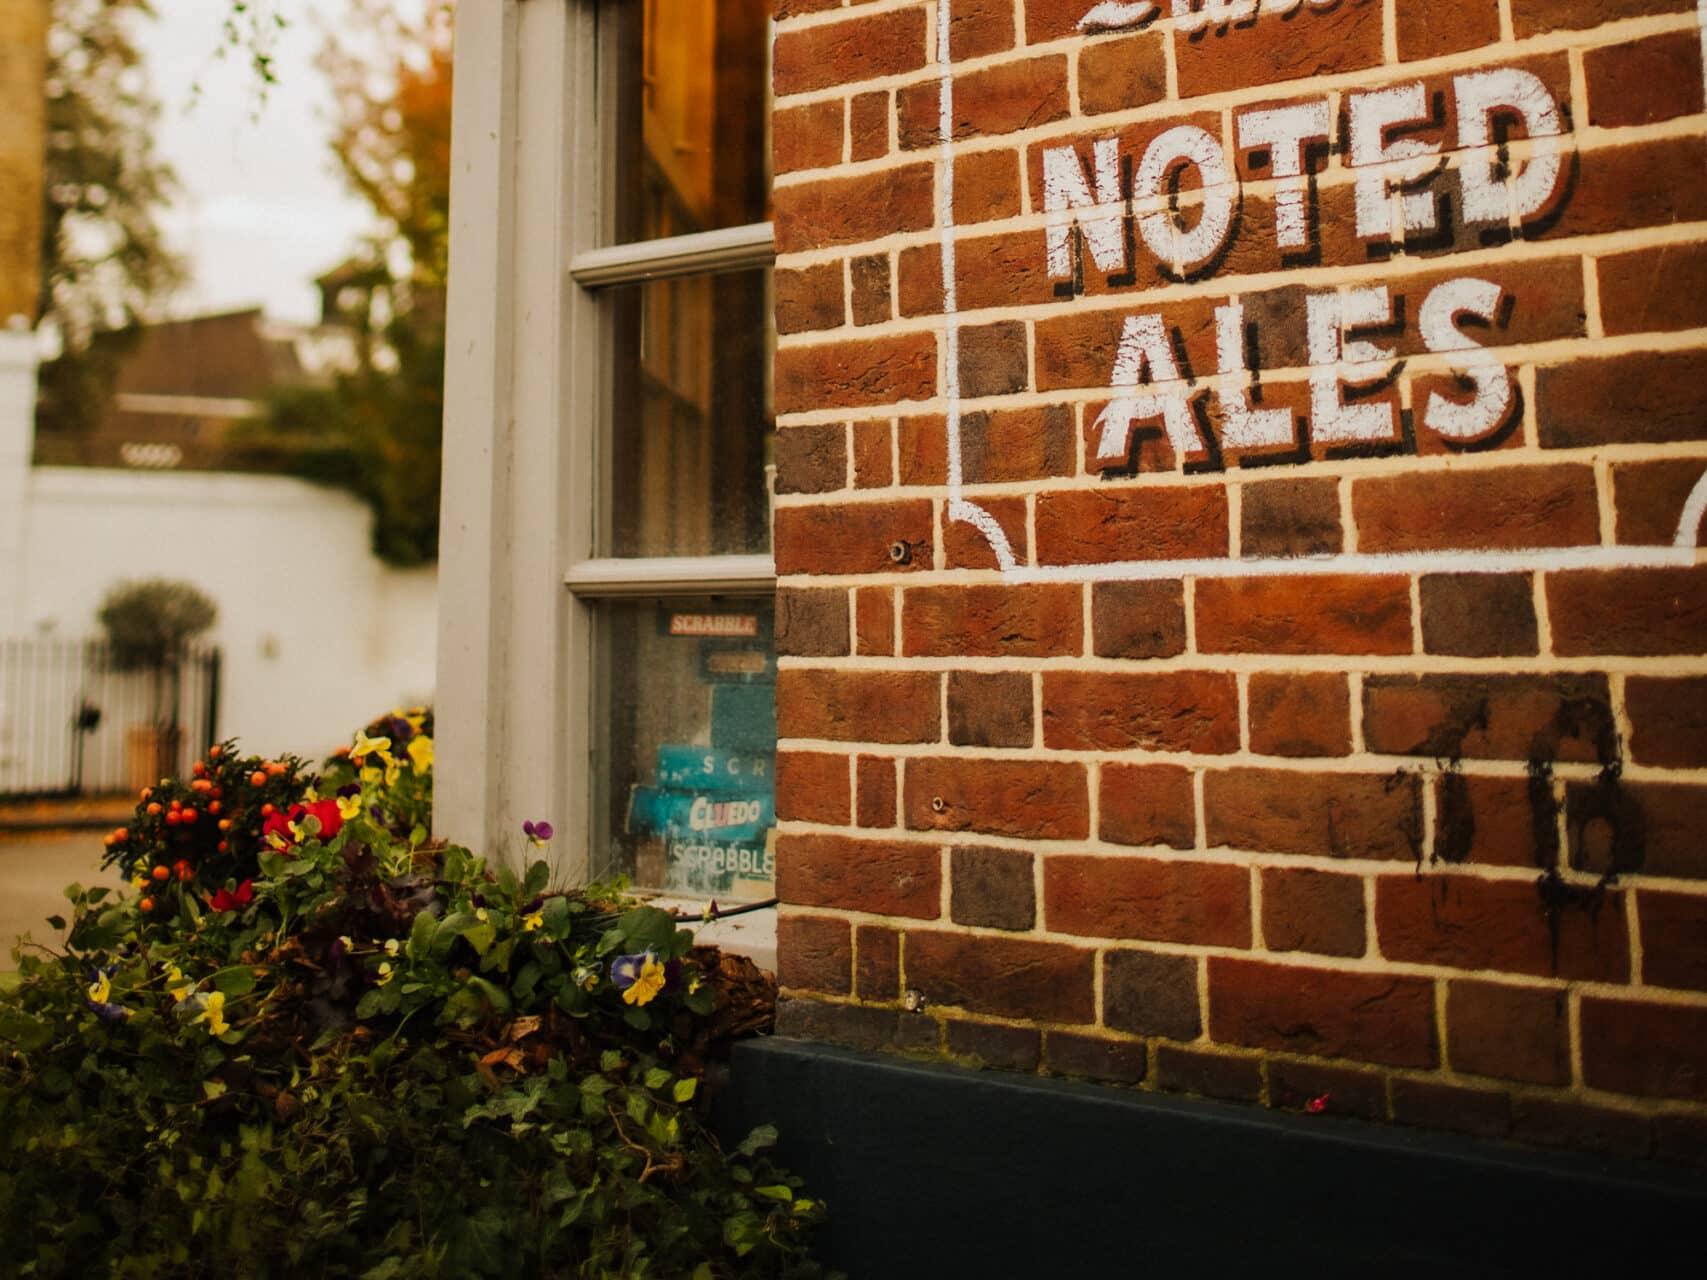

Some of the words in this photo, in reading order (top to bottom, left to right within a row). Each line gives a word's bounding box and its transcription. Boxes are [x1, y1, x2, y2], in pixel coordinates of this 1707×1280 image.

[1042, 66, 1562, 280] NOTED
[1092, 277, 1511, 460] ALES
[672, 615, 755, 634] SCRABBLE
[690, 796, 761, 831] CLUEDO
[673, 843, 775, 874] SCRABBLE
